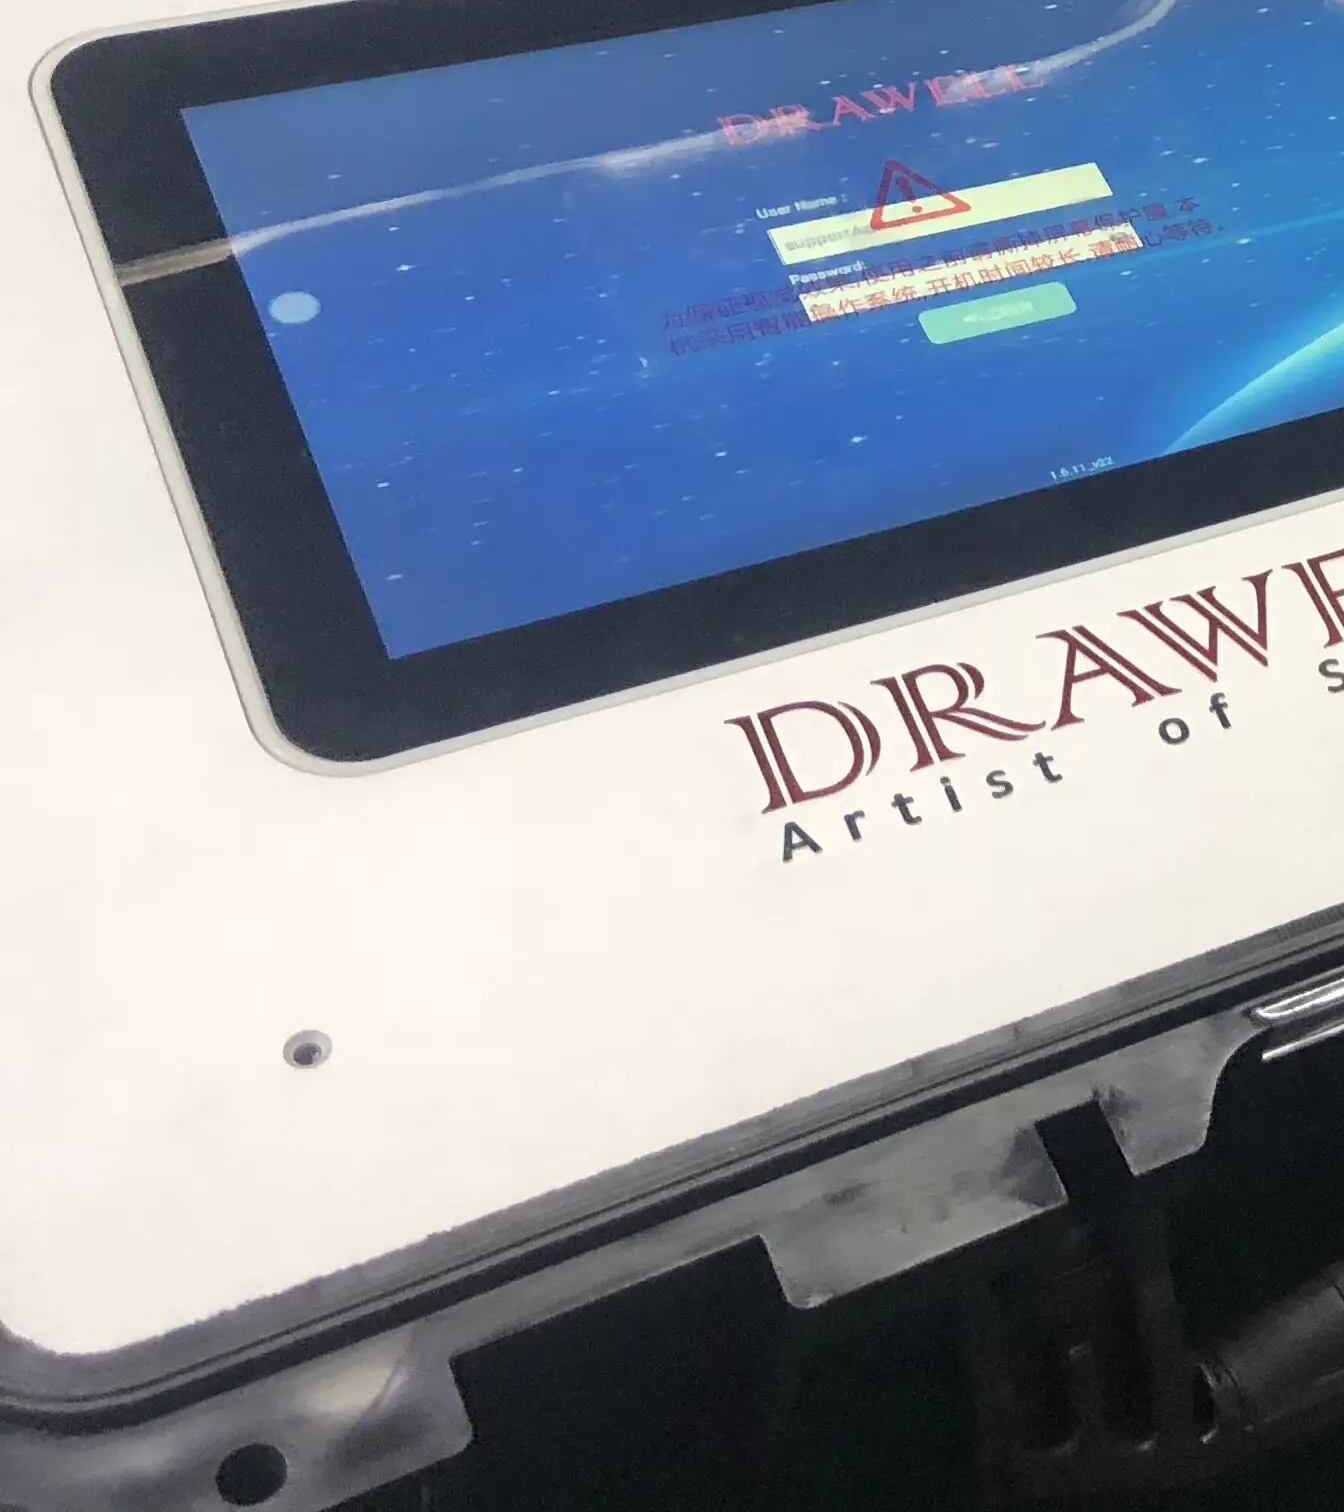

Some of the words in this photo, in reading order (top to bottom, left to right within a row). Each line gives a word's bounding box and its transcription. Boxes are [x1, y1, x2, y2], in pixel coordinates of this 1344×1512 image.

[717, 64, 1044, 146] DRAWELL
[755, 202, 792, 220] User
[794, 194, 838, 214] Name
[780, 750, 1065, 864] Artist
[1157, 691, 1235, 747] of
